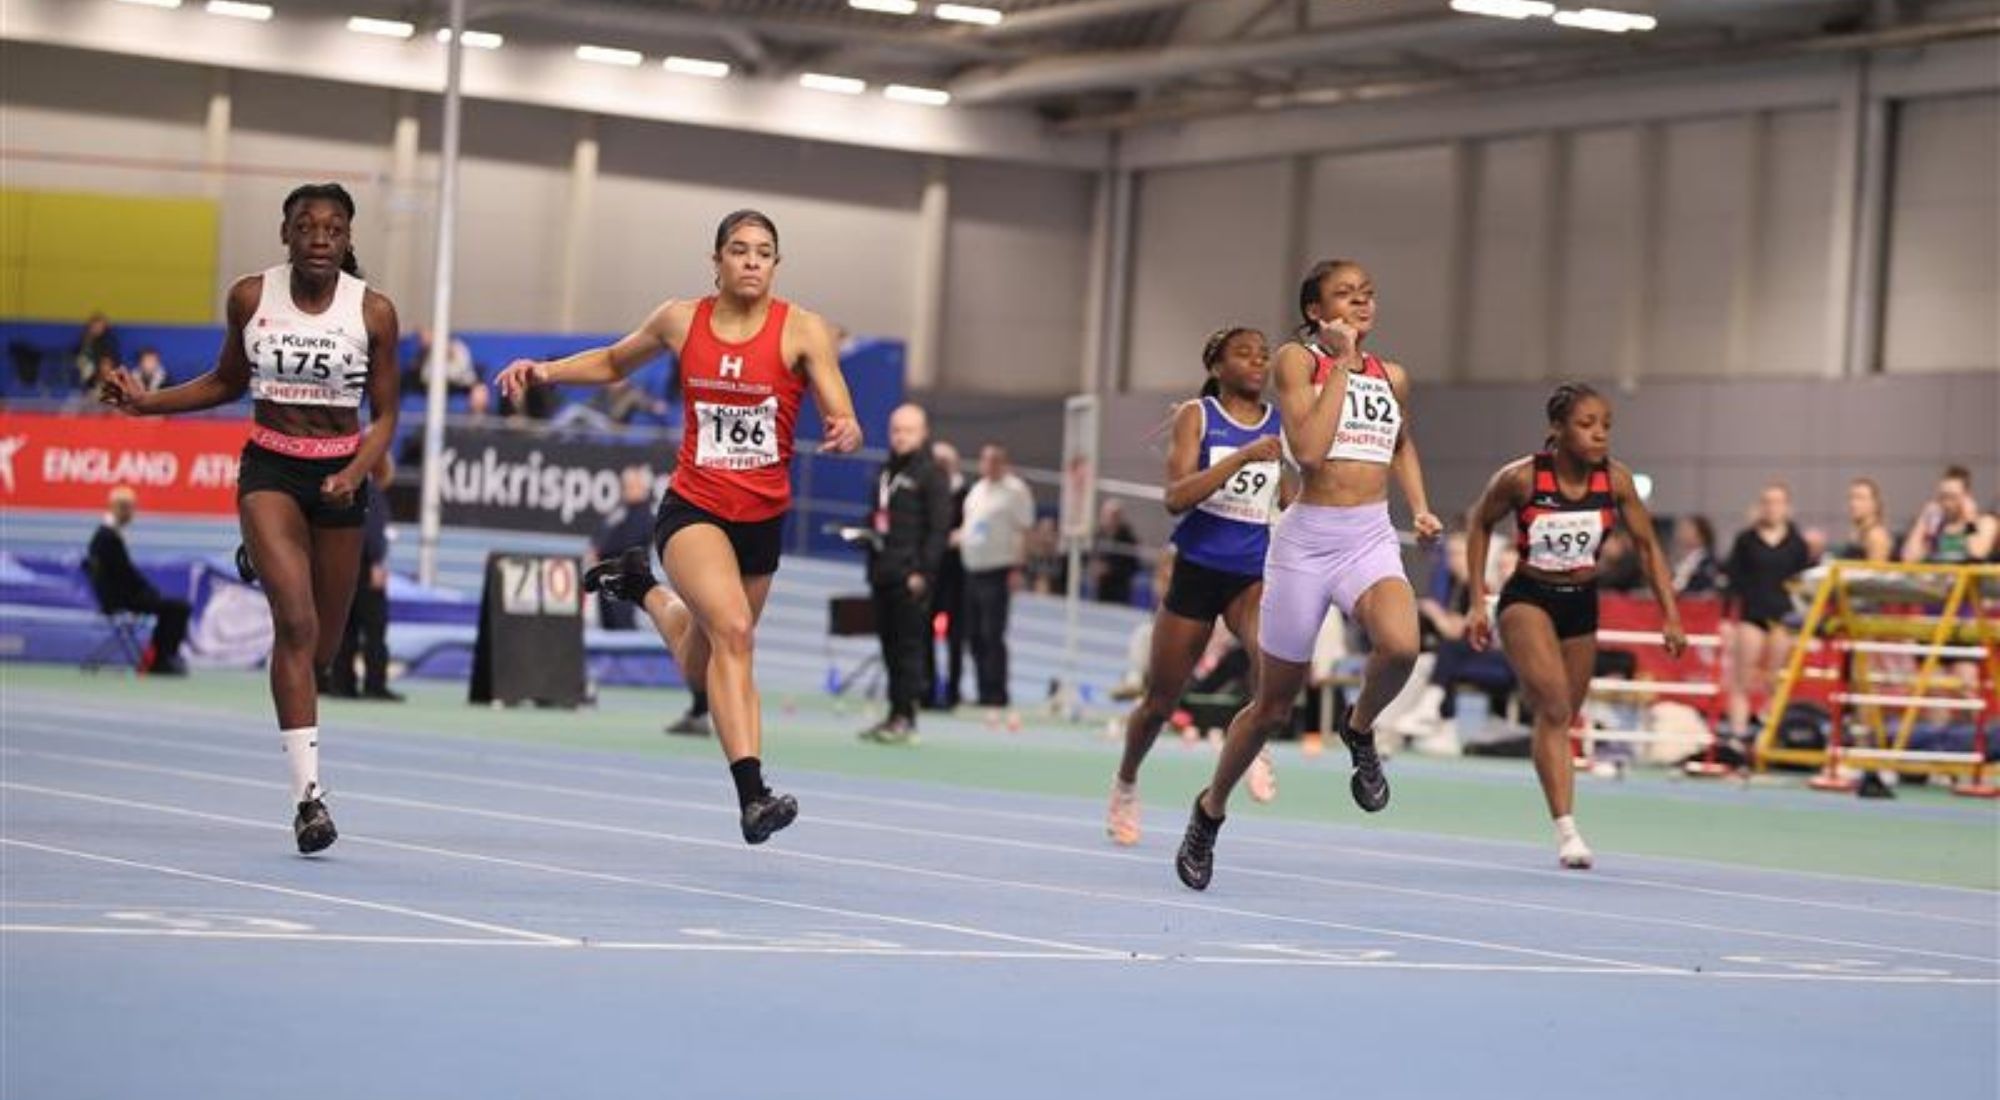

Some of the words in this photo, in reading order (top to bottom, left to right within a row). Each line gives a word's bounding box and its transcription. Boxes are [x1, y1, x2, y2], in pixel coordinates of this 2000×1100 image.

[281, 334, 336, 349] KUKRI
[272, 349, 331, 379] 175
[719, 354, 744, 379] H
[1346, 391, 1394, 423] 162
[712, 416, 766, 446] 166
[43, 448, 179, 486] ENGLAND
[188, 453, 240, 487] ATH
[440, 449, 672, 523] Kukrispos
[1219, 471, 1267, 496] 59
